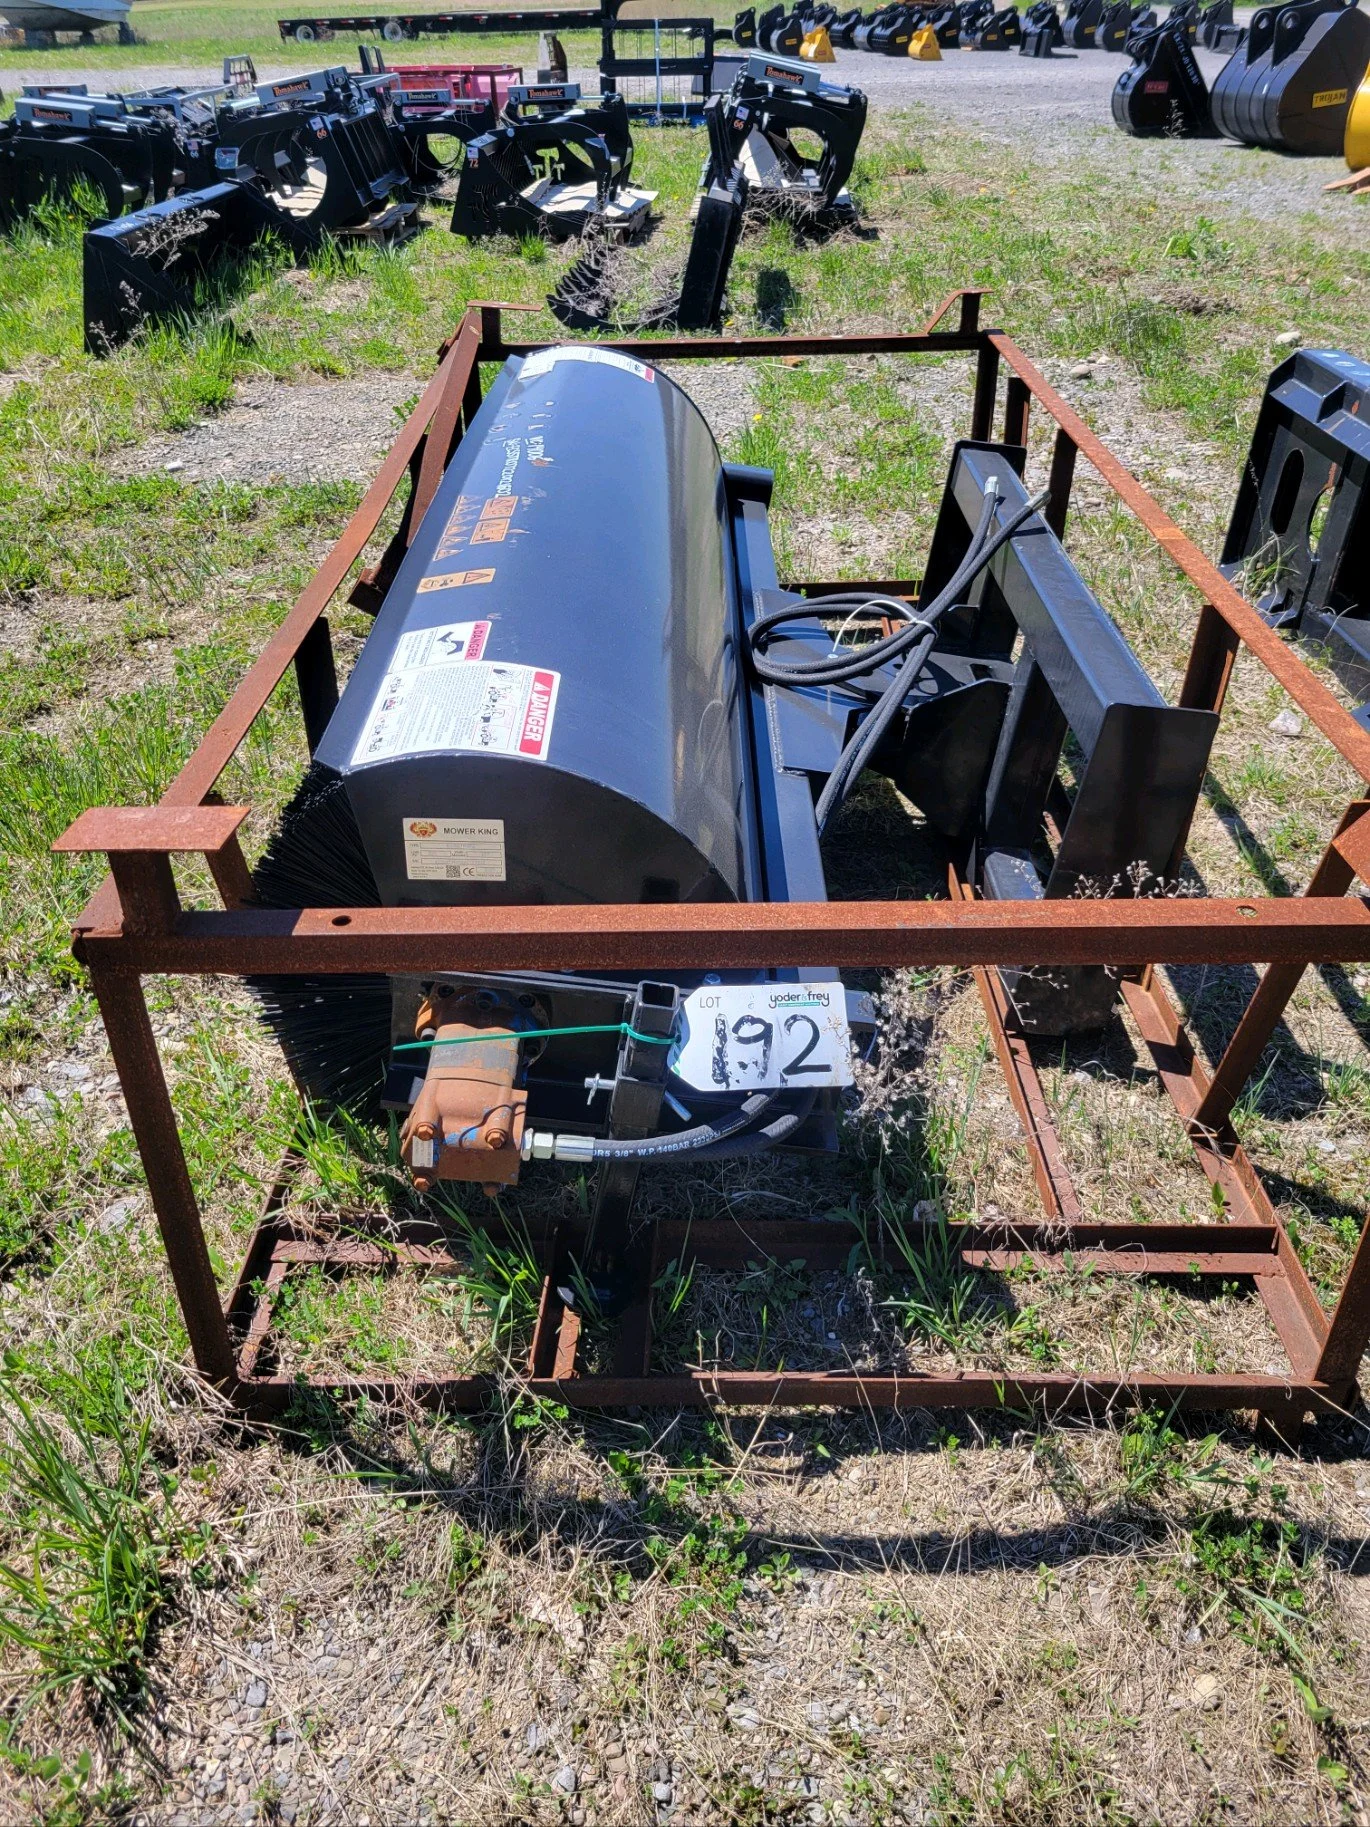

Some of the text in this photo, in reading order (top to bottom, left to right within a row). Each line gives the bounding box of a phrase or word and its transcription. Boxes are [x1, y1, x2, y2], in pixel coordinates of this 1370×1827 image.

[1314, 92, 1346, 103] TROJAN
[316, 129, 328, 140] 66
[468, 158, 479, 168] 72
[465, 630, 484, 659] DANGER
[523, 691, 550, 742] DANGER
[443, 827, 499, 836] MOWER KING
[699, 996, 722, 1009] LOT
[711, 1013, 833, 1086] 192
